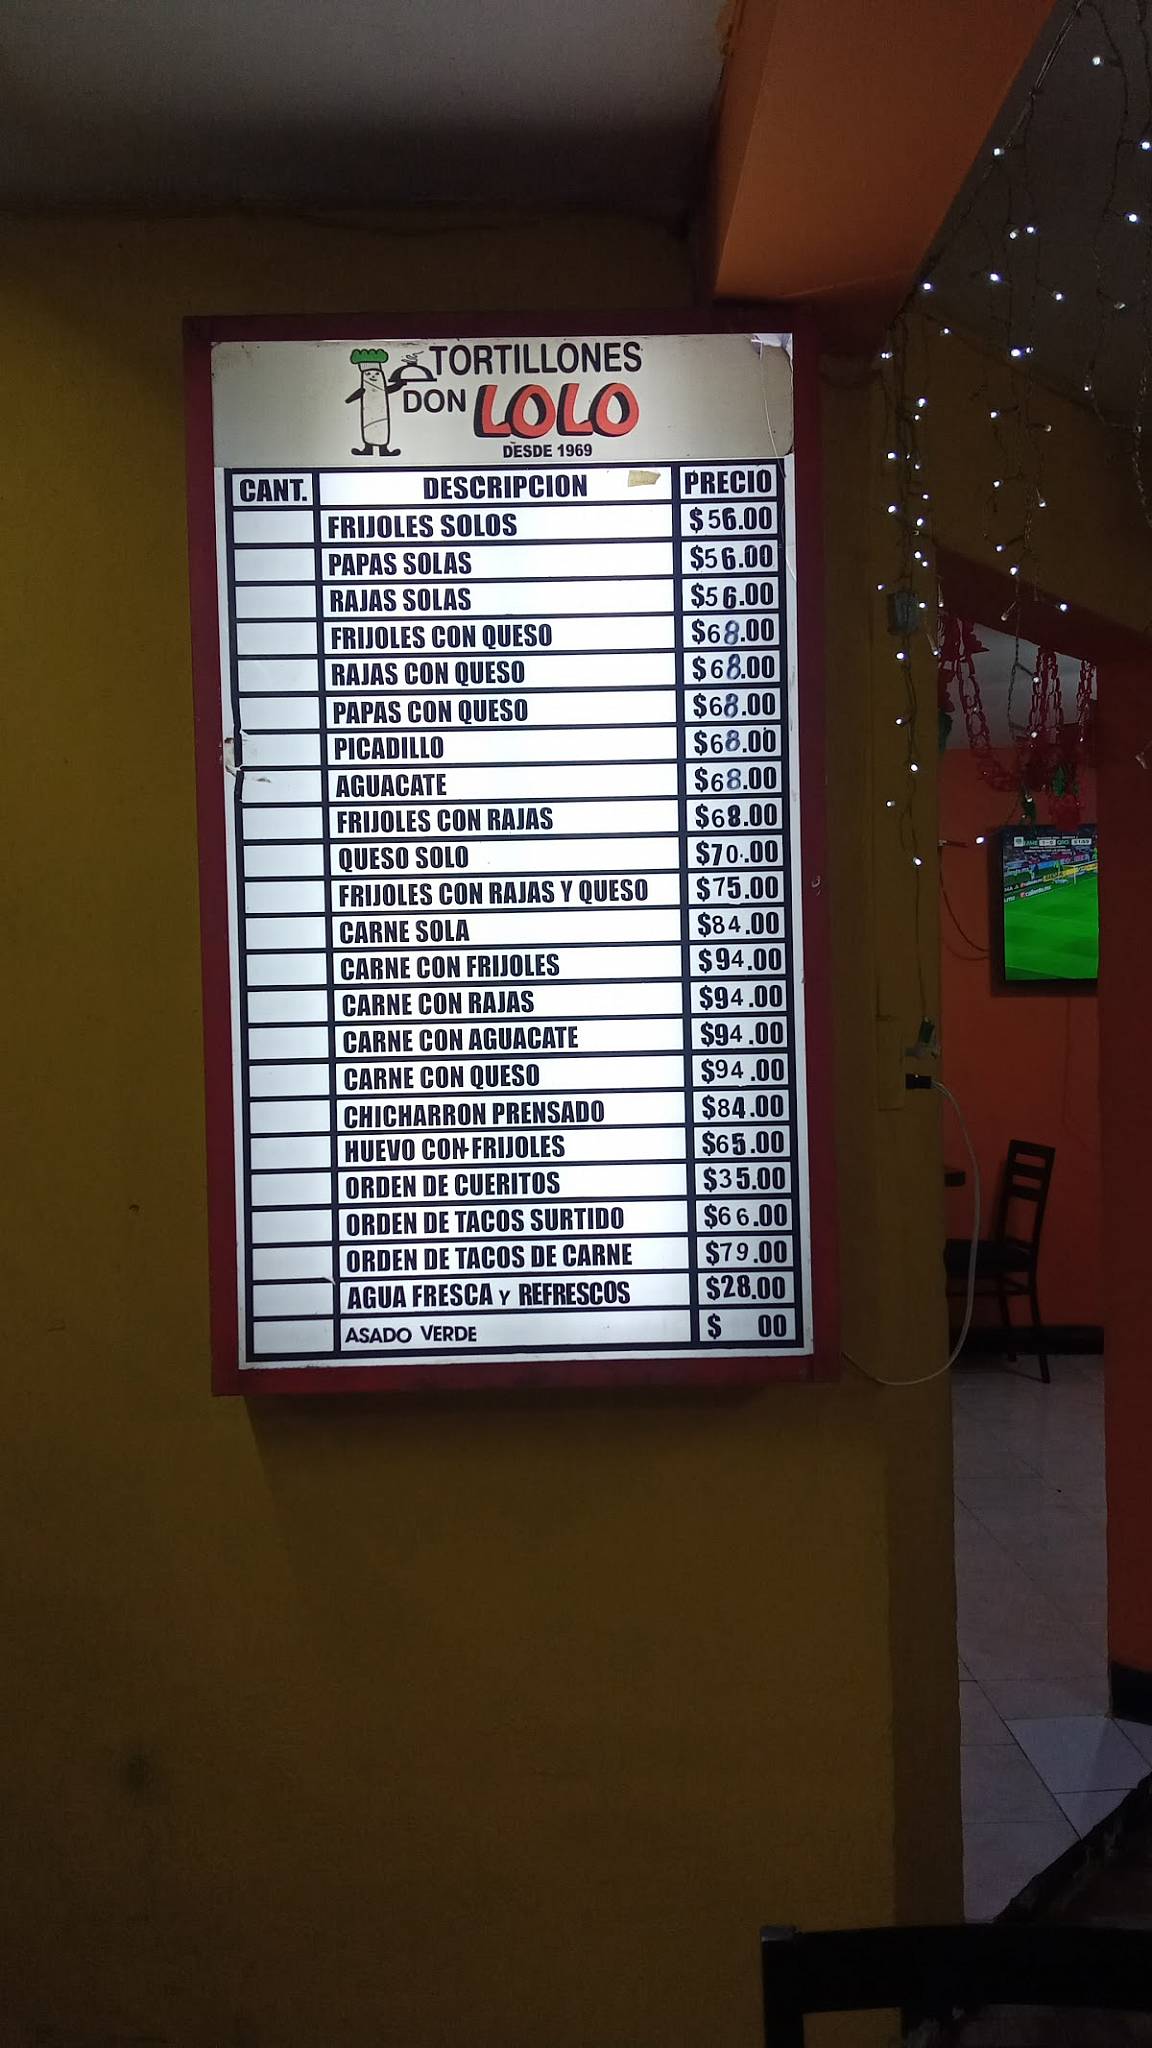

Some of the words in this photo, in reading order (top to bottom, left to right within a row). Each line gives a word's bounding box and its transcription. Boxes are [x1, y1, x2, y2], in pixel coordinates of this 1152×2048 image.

[429, 342, 642, 376] TORTILLONES
[403, 389, 466, 413] DON
[473, 382, 640, 439] LOLO
[503, 444, 553, 459] DESDE
[556, 443, 593, 457] 1969
[240, 478, 308, 502] CANT.
[423, 474, 588, 500] DESCRIPCION
[684, 468, 772, 495] PRECIO
[327, 514, 434, 539] FRIJOLES
[440, 513, 518, 538] SOLOS
[689, 505, 773, 534] $56.00
[328, 552, 398, 577] PAPAS
[402, 551, 472, 576] SOLAS
[690, 544, 773, 572] $56.00
[329, 588, 397, 613] RAJAS
[402, 587, 472, 612] SOLAS
[690, 581, 774, 610] $56.00
[331, 625, 426, 650] FRIJOLES
[431, 625, 476, 649] CON
[482, 623, 553, 650] QUESO
[691, 617, 775, 646] $68.00
[331, 662, 398, 686] RAJAS
[404, 661, 449, 685] CON
[454, 660, 525, 687] QUESO
[692, 653, 775, 683] $68.00
[333, 700, 402, 725] PAPAS
[407, 700, 452, 724] CON
[458, 698, 528, 725] QUESO
[692, 692, 776, 719] $68.00
[334, 735, 444, 761] PICADILLO
[693, 726, 777, 757] $68.00
[335, 773, 447, 798] AGUACATE
[694, 766, 777, 793] $68.00
[337, 809, 431, 834] FRIJOLES
[437, 808, 481, 832] CON
[487, 806, 554, 831] RAJAS
[695, 802, 778, 830] $68.00
[338, 846, 409, 873] QUESO
[415, 845, 469, 869] SOLO
[339, 882, 433, 908] FRIJOLES
[439, 882, 483, 906] CON
[488, 880, 555, 905] RAJAS
[560, 880, 573, 903] Y
[578, 878, 648, 905] QUESO
[696, 875, 779, 903] $75.00
[339, 920, 410, 945] CARNE
[415, 919, 470, 943] SOLA
[697, 911, 780, 938] $84.00
[340, 956, 411, 981] CARNE
[416, 955, 461, 979] CON
[466, 953, 560, 978] FRIJOLES
[698, 947, 782, 974] $94.00
[342, 993, 413, 1017] CARNE
[418, 992, 462, 1016] CON
[468, 990, 535, 1014] RAJAS
[699, 984, 783, 1011] $94.00
[343, 1029, 414, 1054] CARNE
[419, 1028, 463, 1052] CON
[468, 1025, 579, 1051] AGUACATE
[700, 1021, 784, 1048] $94.00
[344, 1067, 414, 1091] CARNE
[420, 1065, 464, 1089] CON
[470, 1063, 540, 1090] QUESO
[701, 1058, 785, 1085] $94.00
[344, 1102, 486, 1129] CHICHARRON
[492, 1099, 605, 1125] PRENSADO
[701, 1094, 784, 1121] $84.00
[344, 1138, 416, 1163] HUEVO
[701, 1130, 785, 1157] $65.00
[345, 1175, 417, 1200] ORDEN
[422, 1174, 449, 1197] DE
[454, 1171, 560, 1197] CUERITOS
[703, 1166, 786, 1193] $35.00
[346, 1212, 417, 1237] ORDEN
[423, 1211, 450, 1234] DE
[454, 1208, 525, 1233] TACOS
[530, 1206, 624, 1232] SURTIDO
[703, 1203, 788, 1230] $66.00
[346, 1248, 418, 1273] ORDEN
[424, 1247, 450, 1271] DE
[454, 1245, 525, 1270] TACOS
[531, 1244, 557, 1268] DE
[562, 1243, 633, 1267] CARNE
[705, 1239, 788, 1267] $79.00
[347, 1285, 407, 1310] AGUA
[412, 1282, 494, 1308] FRESCA
[498, 1289, 511, 1306] Y
[518, 1280, 631, 1306] REFRESCOS
[705, 1274, 786, 1301] $28.00
[344, 1327, 413, 1344] ASADO
[420, 1324, 477, 1343] VERDE
